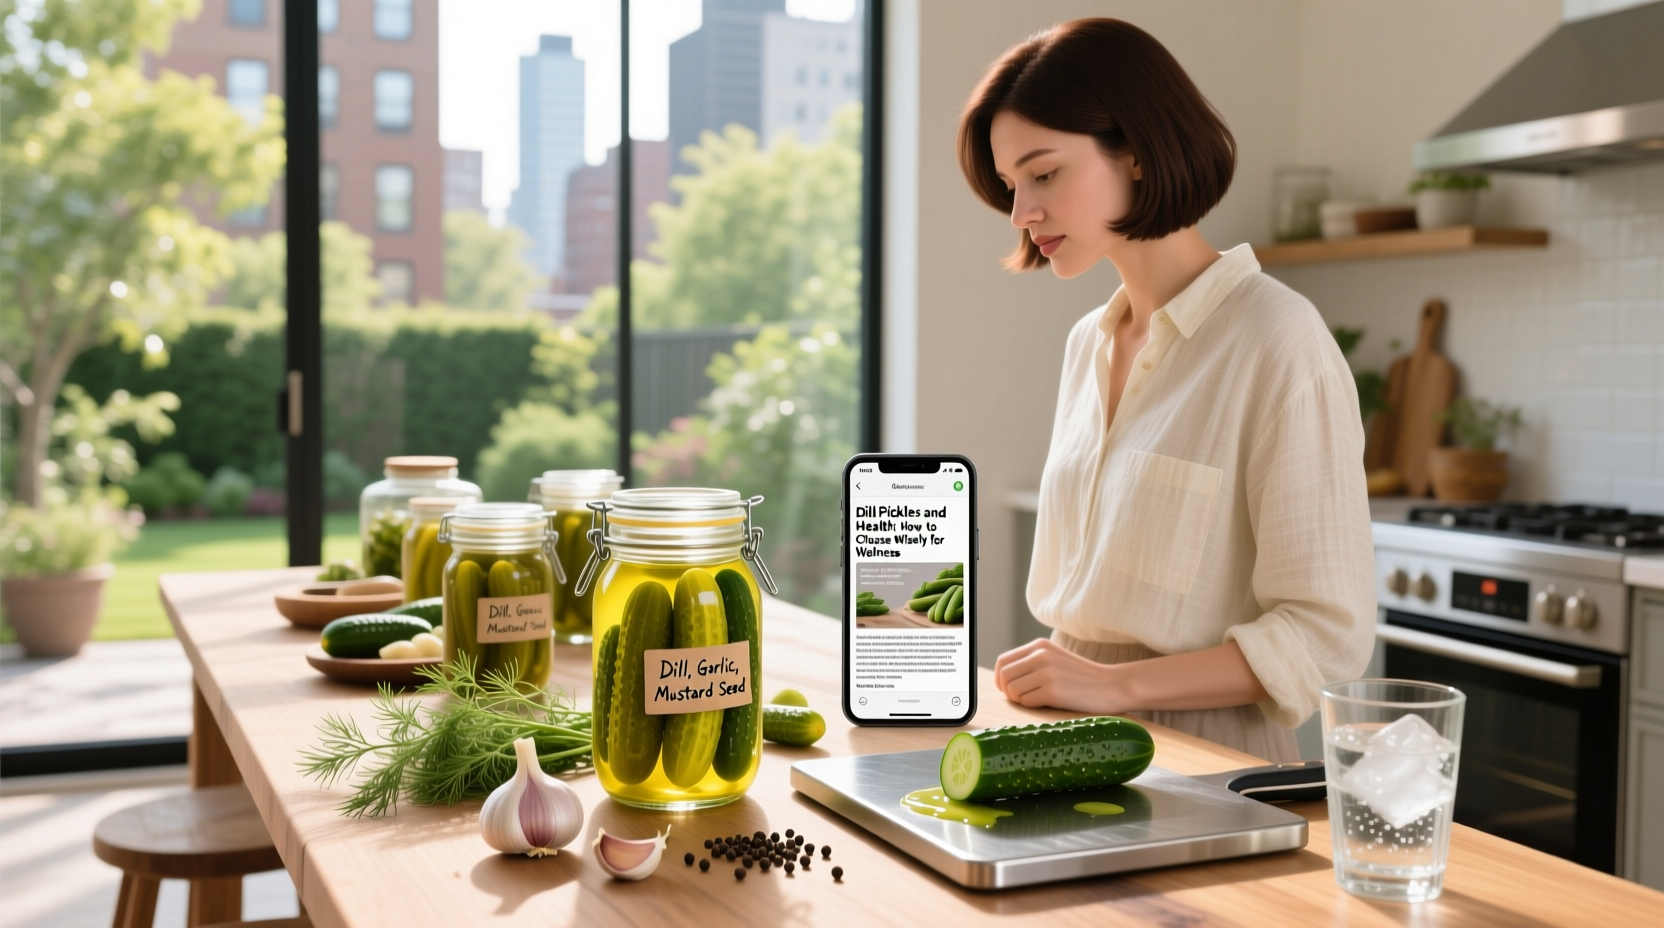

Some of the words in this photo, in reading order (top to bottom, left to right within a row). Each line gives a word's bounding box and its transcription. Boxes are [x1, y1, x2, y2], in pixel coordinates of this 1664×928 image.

[856, 505, 876, 518] Dill
[879, 505, 921, 518] Pickles
[924, 506, 947, 518] and
[901, 520, 922, 532] How
[660, 659, 692, 679] Dill,
[697, 656, 739, 676] Garlic,
[654, 681, 713, 702] Mustard
